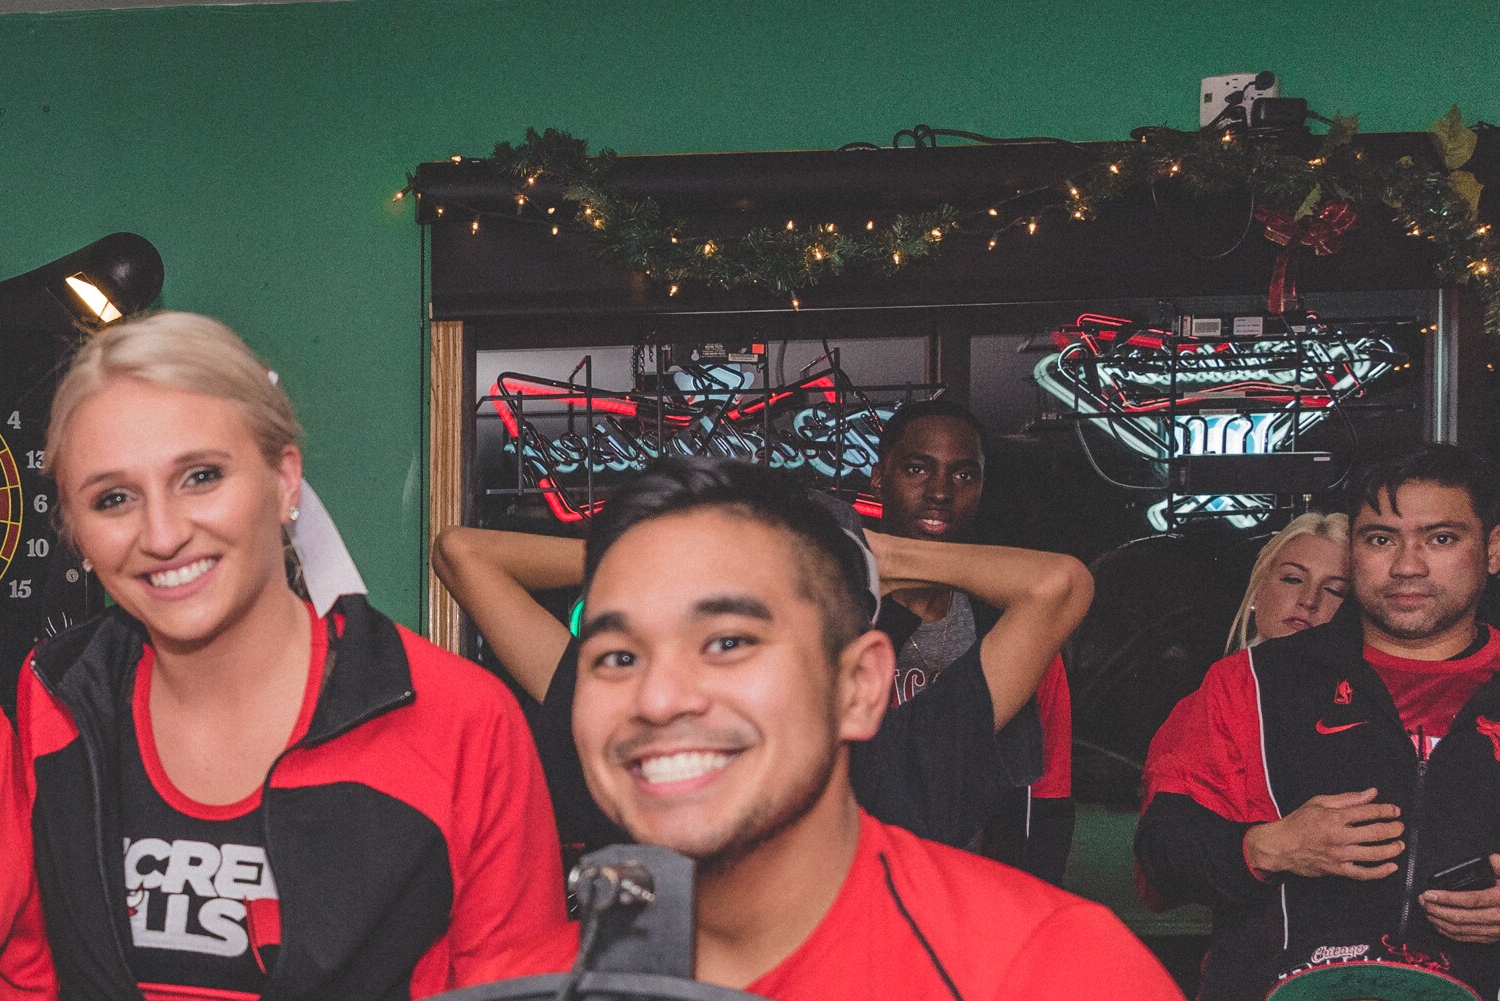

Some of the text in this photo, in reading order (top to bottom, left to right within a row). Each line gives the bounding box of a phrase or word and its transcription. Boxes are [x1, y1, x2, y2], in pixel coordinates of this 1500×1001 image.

[7, 410, 22, 430] 4
[33, 493, 48, 514] 6
[26, 538, 50, 558] 10
[9, 578, 32, 599] 15
[123, 837, 279, 902] CRE
[1310, 944, 1370, 964] Chicago
